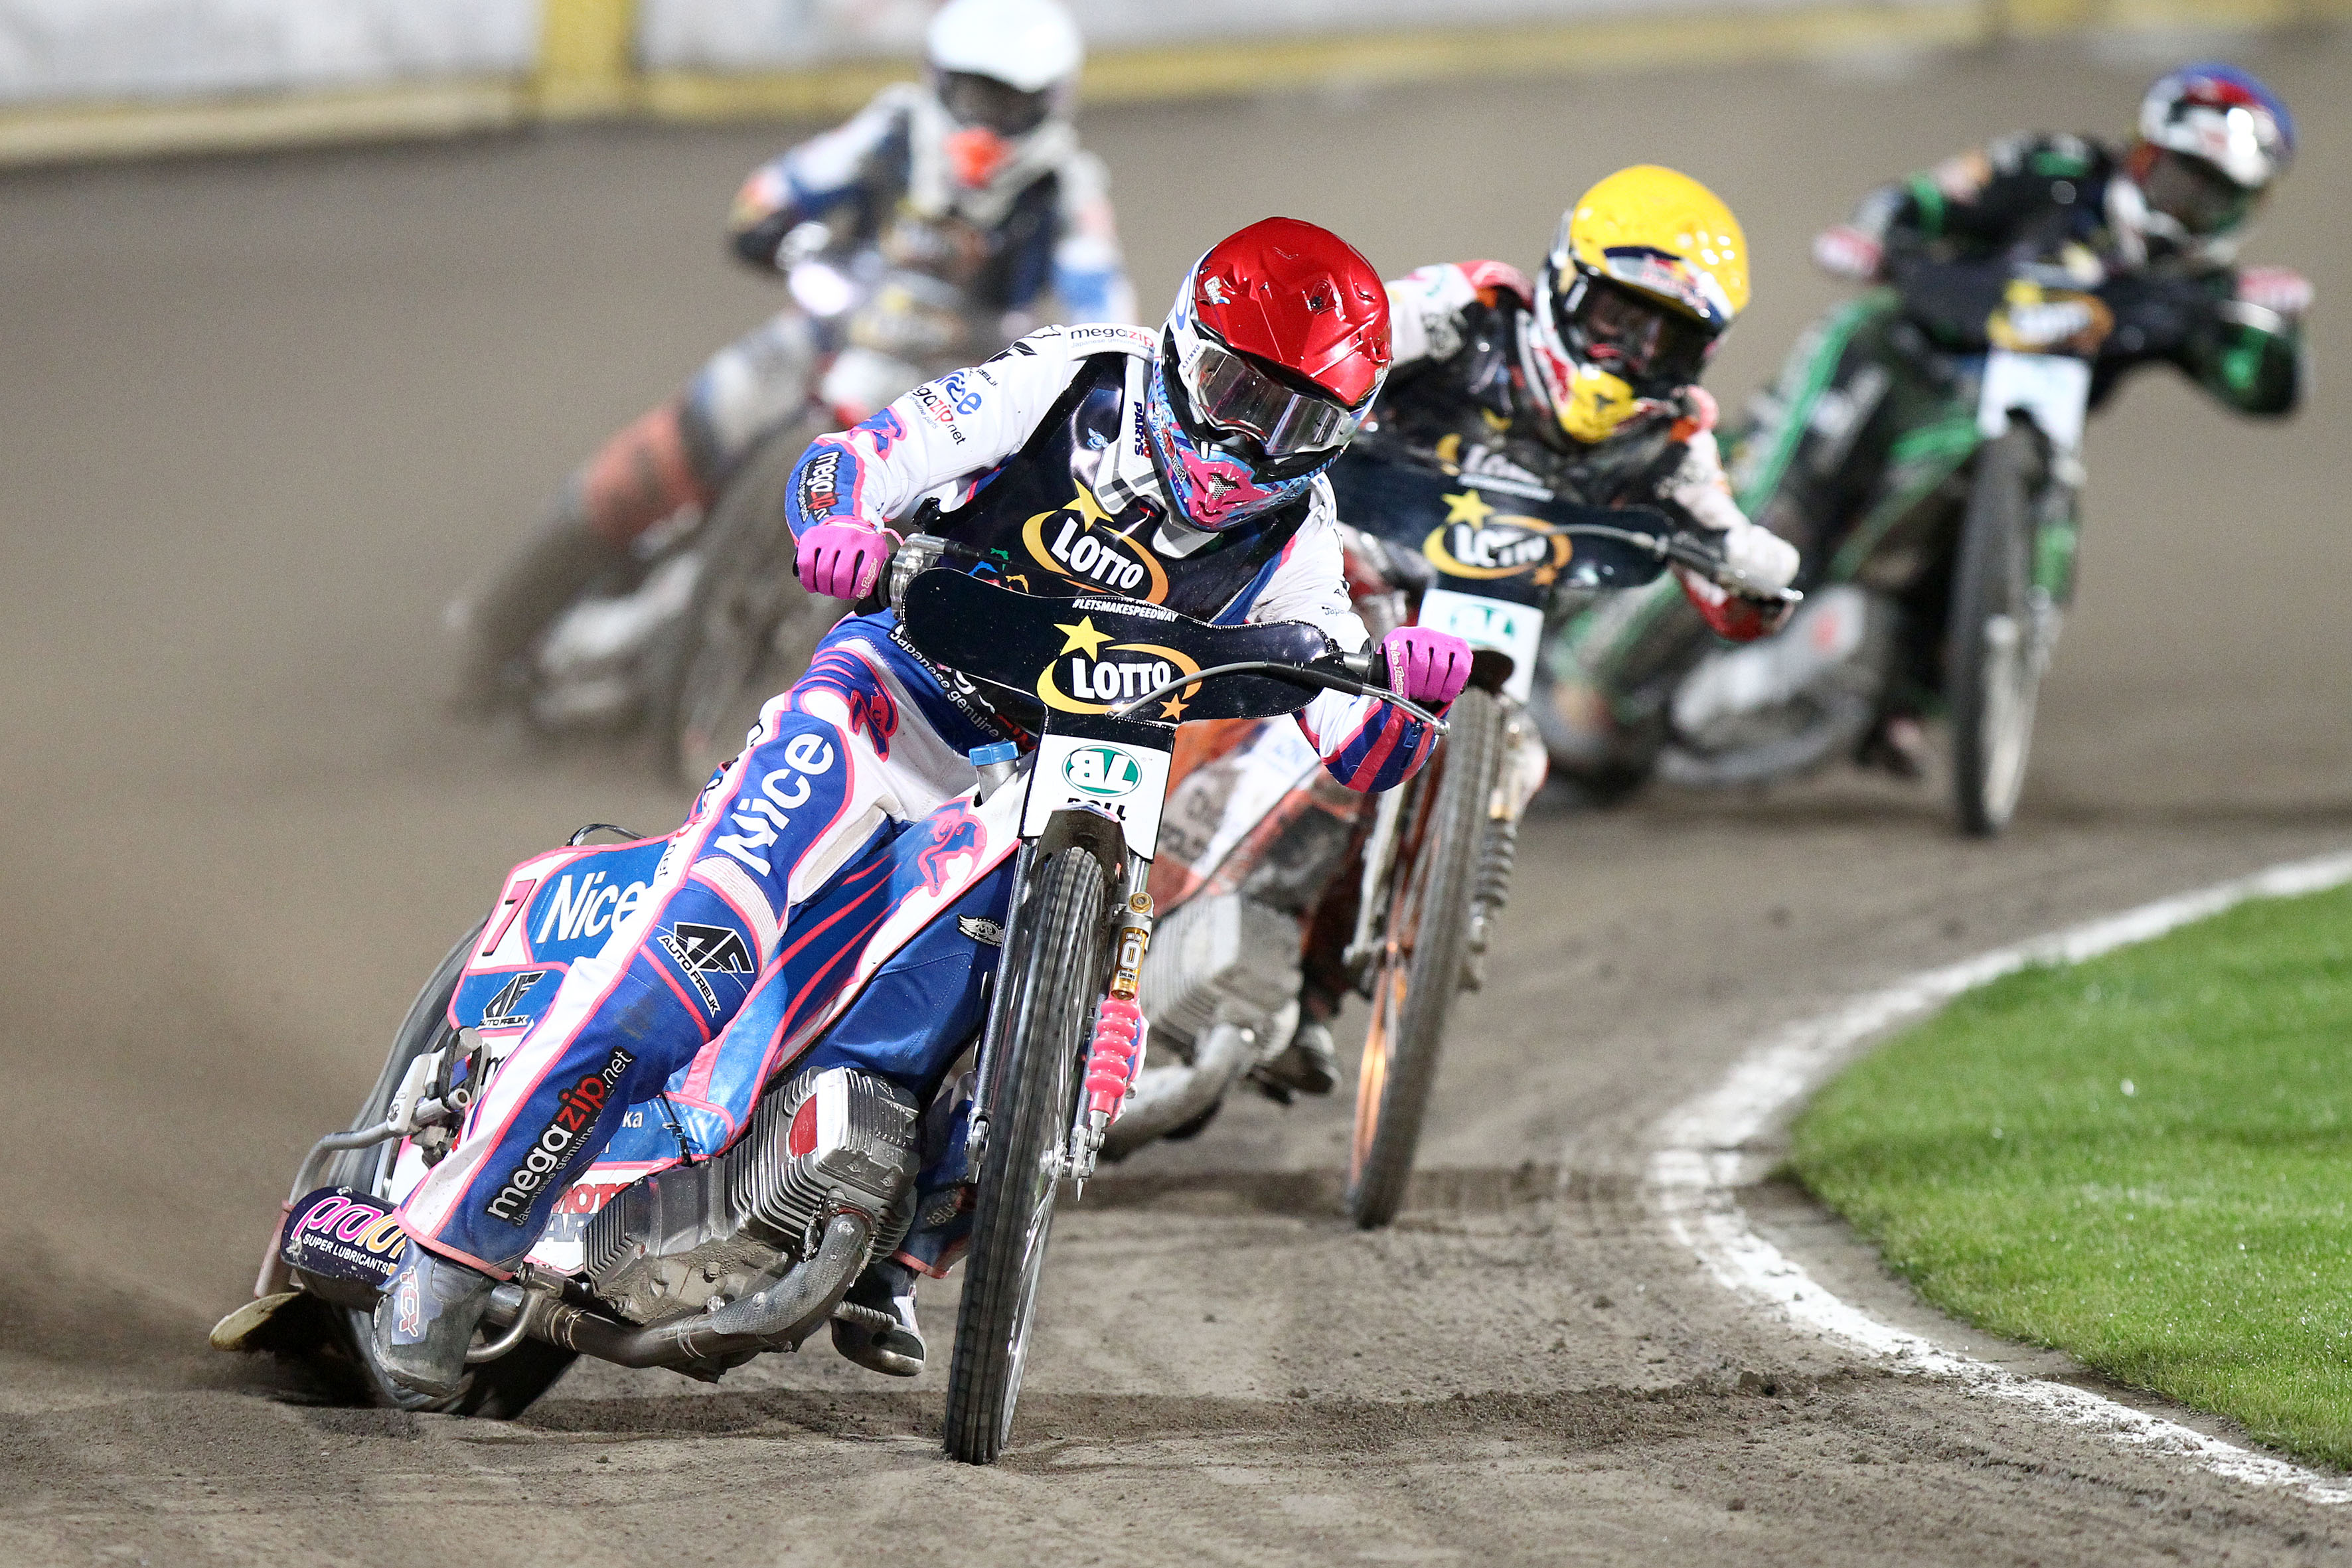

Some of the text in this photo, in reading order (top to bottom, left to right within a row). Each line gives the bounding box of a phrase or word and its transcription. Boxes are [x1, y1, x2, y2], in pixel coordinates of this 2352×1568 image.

[1182, 344, 1200, 369] OAKLEY
[1050, 516, 1144, 589] LOTTO
[1072, 598, 1179, 622] #LETSMAKESPEEDWAY
[890, 632, 951, 689] Japanese
[947, 690, 999, 738] genuine
[1071, 657, 1172, 700] LOTTO
[713, 733, 834, 877] Nice
[535, 870, 646, 944] Nice
[661, 937, 718, 1011] AUTO FRELIK
[487, 1050, 633, 1219] megazip.net
[556, 1124, 596, 1170] genuine
[303, 1233, 388, 1274] SUPER LUBRICANTS
[399, 1266, 419, 1337] TCX
